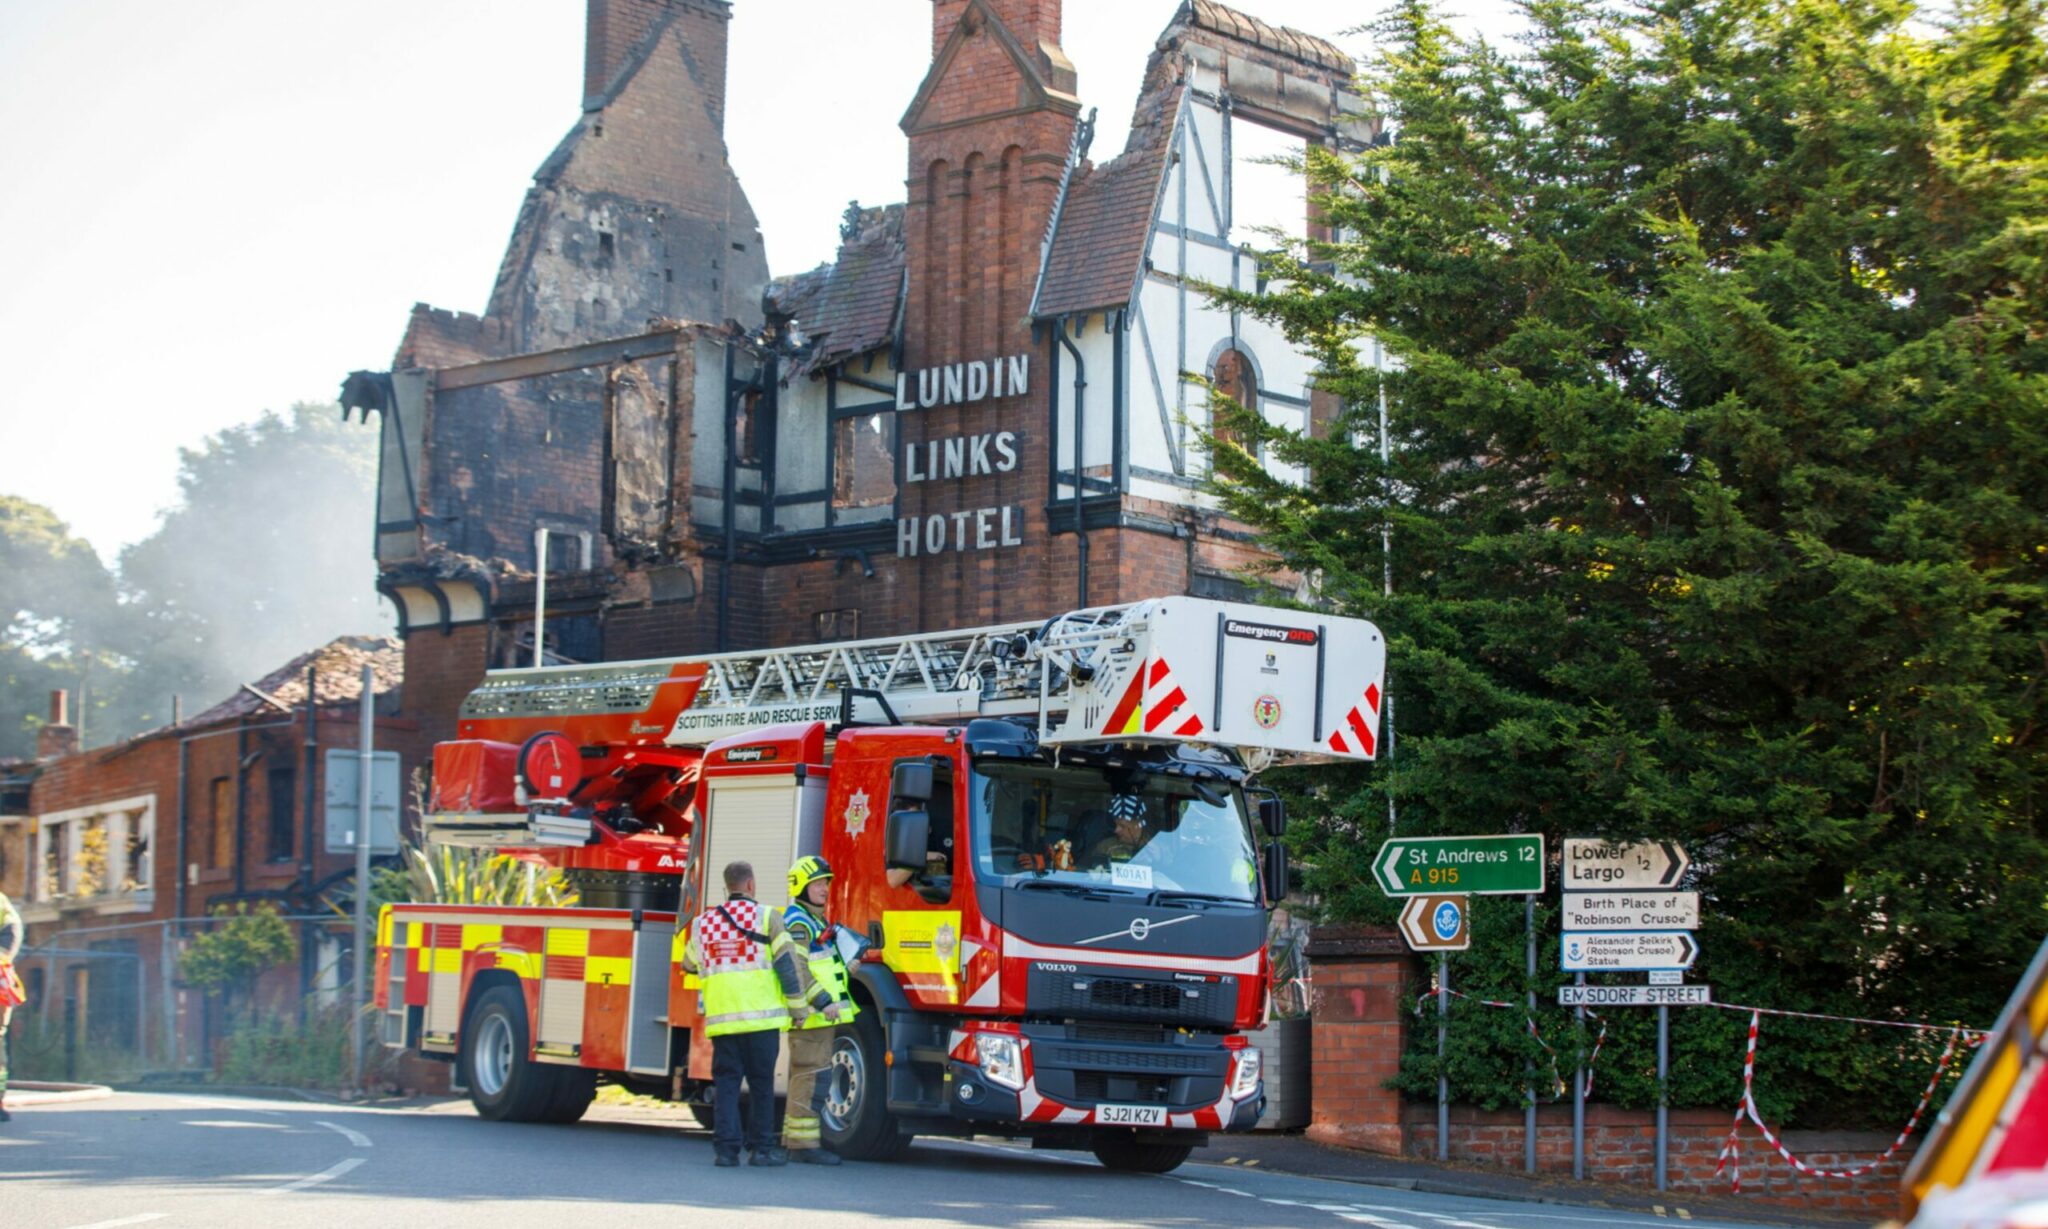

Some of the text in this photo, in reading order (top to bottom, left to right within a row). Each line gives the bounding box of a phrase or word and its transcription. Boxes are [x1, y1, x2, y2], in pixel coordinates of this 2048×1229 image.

[896, 354, 1028, 411] LUNDIN
[906, 431, 1017, 482] LINKS
[897, 506, 1021, 558] HOTEL
[678, 713, 723, 729] SCOTTISH
[725, 711, 746, 726] FIRE
[747, 710, 770, 725] AND
[772, 706, 810, 723] RESCUE
[1409, 846, 1535, 865] St Andrews 12
[1573, 845, 1627, 860] Lower
[1410, 867, 1459, 884] A 915
[1573, 865, 1624, 882] Largo
[1584, 897, 1677, 909] Birth Place of
[1587, 937, 1673, 945] Alexander Selkirk
[1586, 946, 1675, 956] (Robinson Crusoe)
[1036, 962, 1077, 973] VOLVO
[1587, 956, 1620, 966] Statue
[1563, 987, 1705, 1003] EMSDORF STREET
[1103, 1107, 1159, 1123] SJ21 KZV
